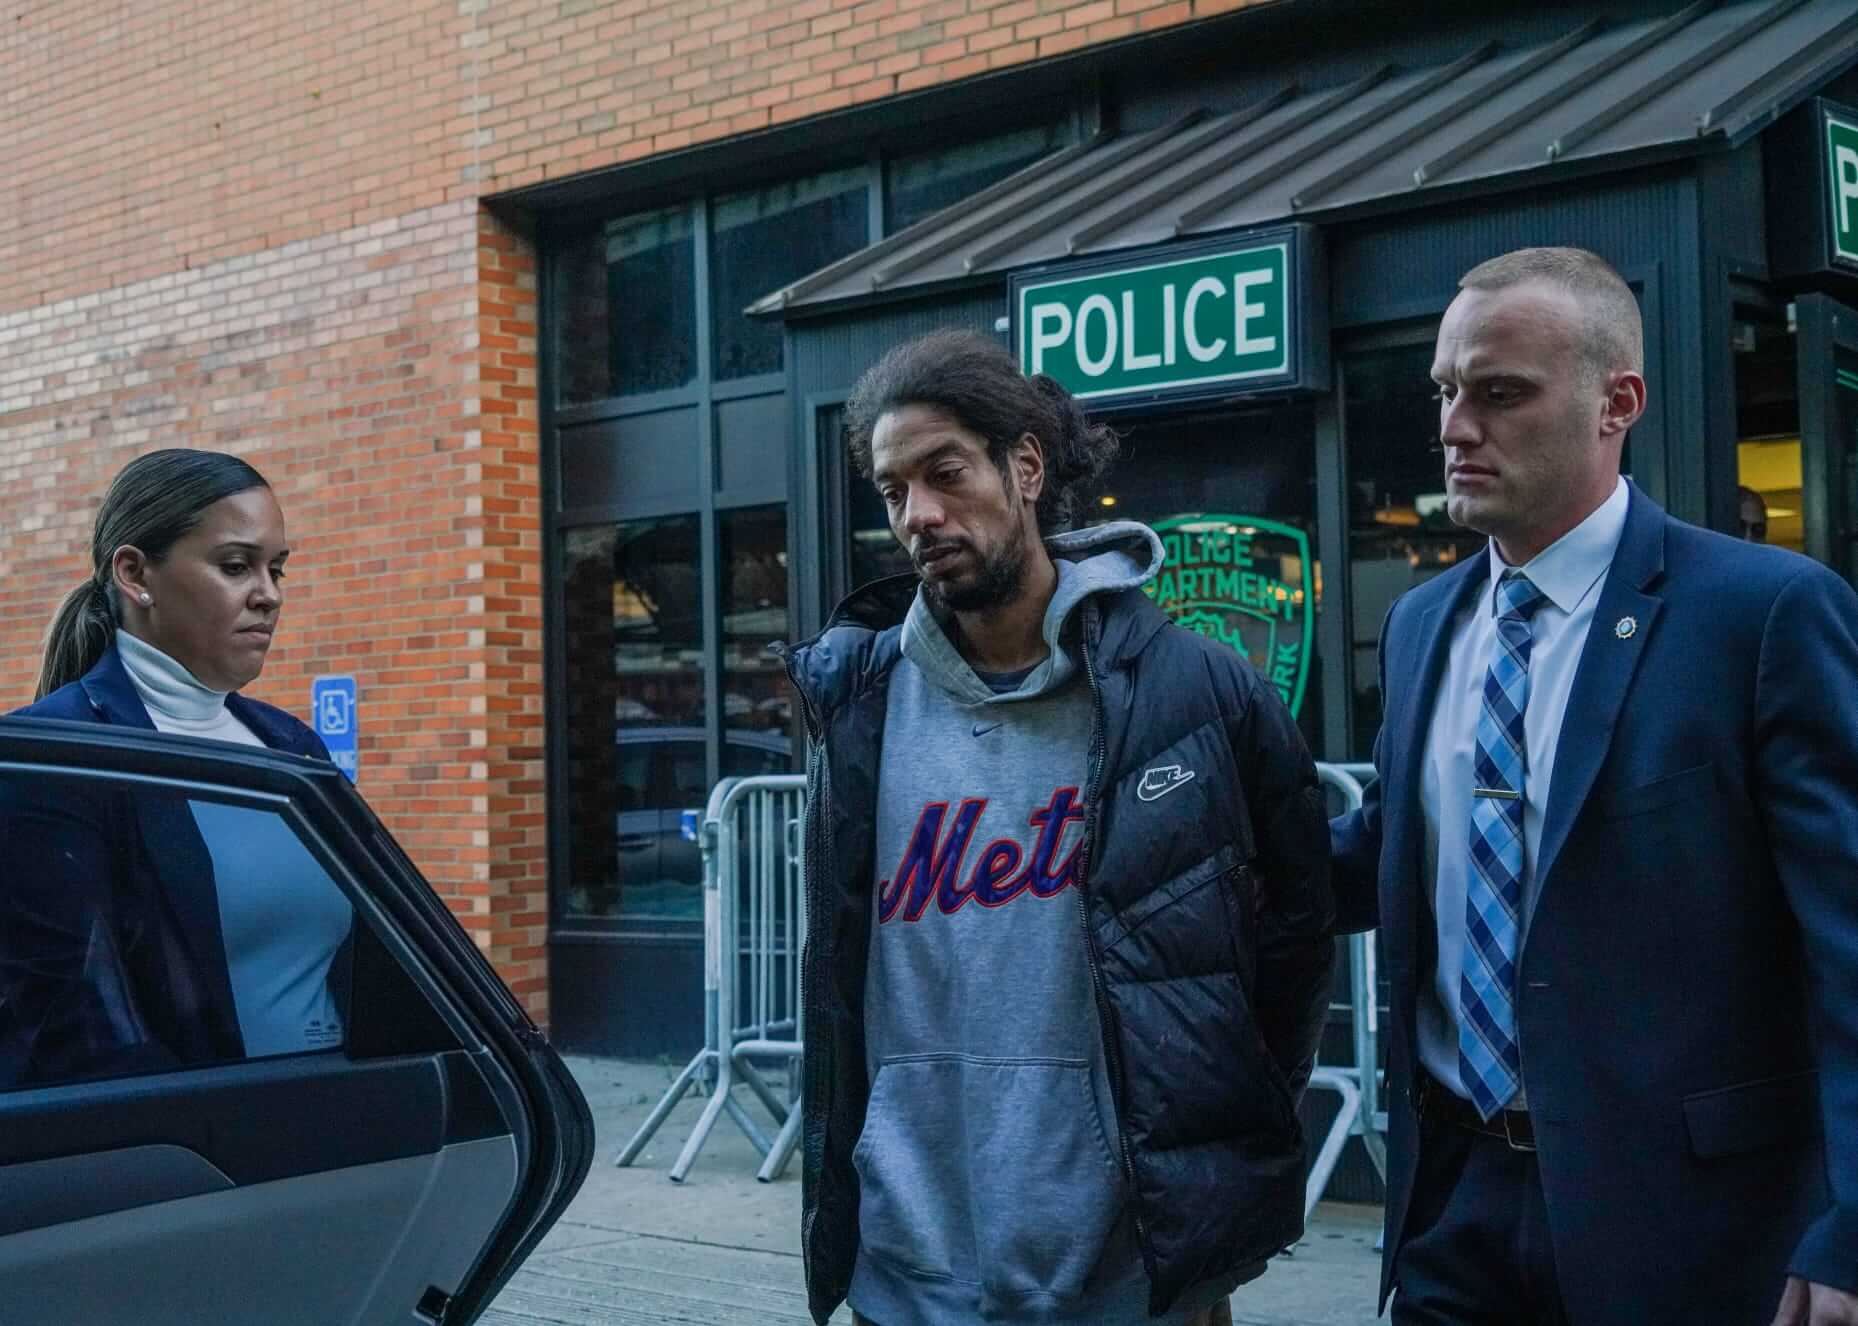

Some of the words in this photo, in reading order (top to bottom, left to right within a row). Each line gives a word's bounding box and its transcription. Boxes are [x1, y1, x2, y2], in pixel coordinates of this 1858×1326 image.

[1031, 268, 1276, 377] POLICE
[1163, 528, 1254, 567] OLICE
[1140, 566, 1298, 621] PARTMENT
[1272, 641, 1300, 705] RK
